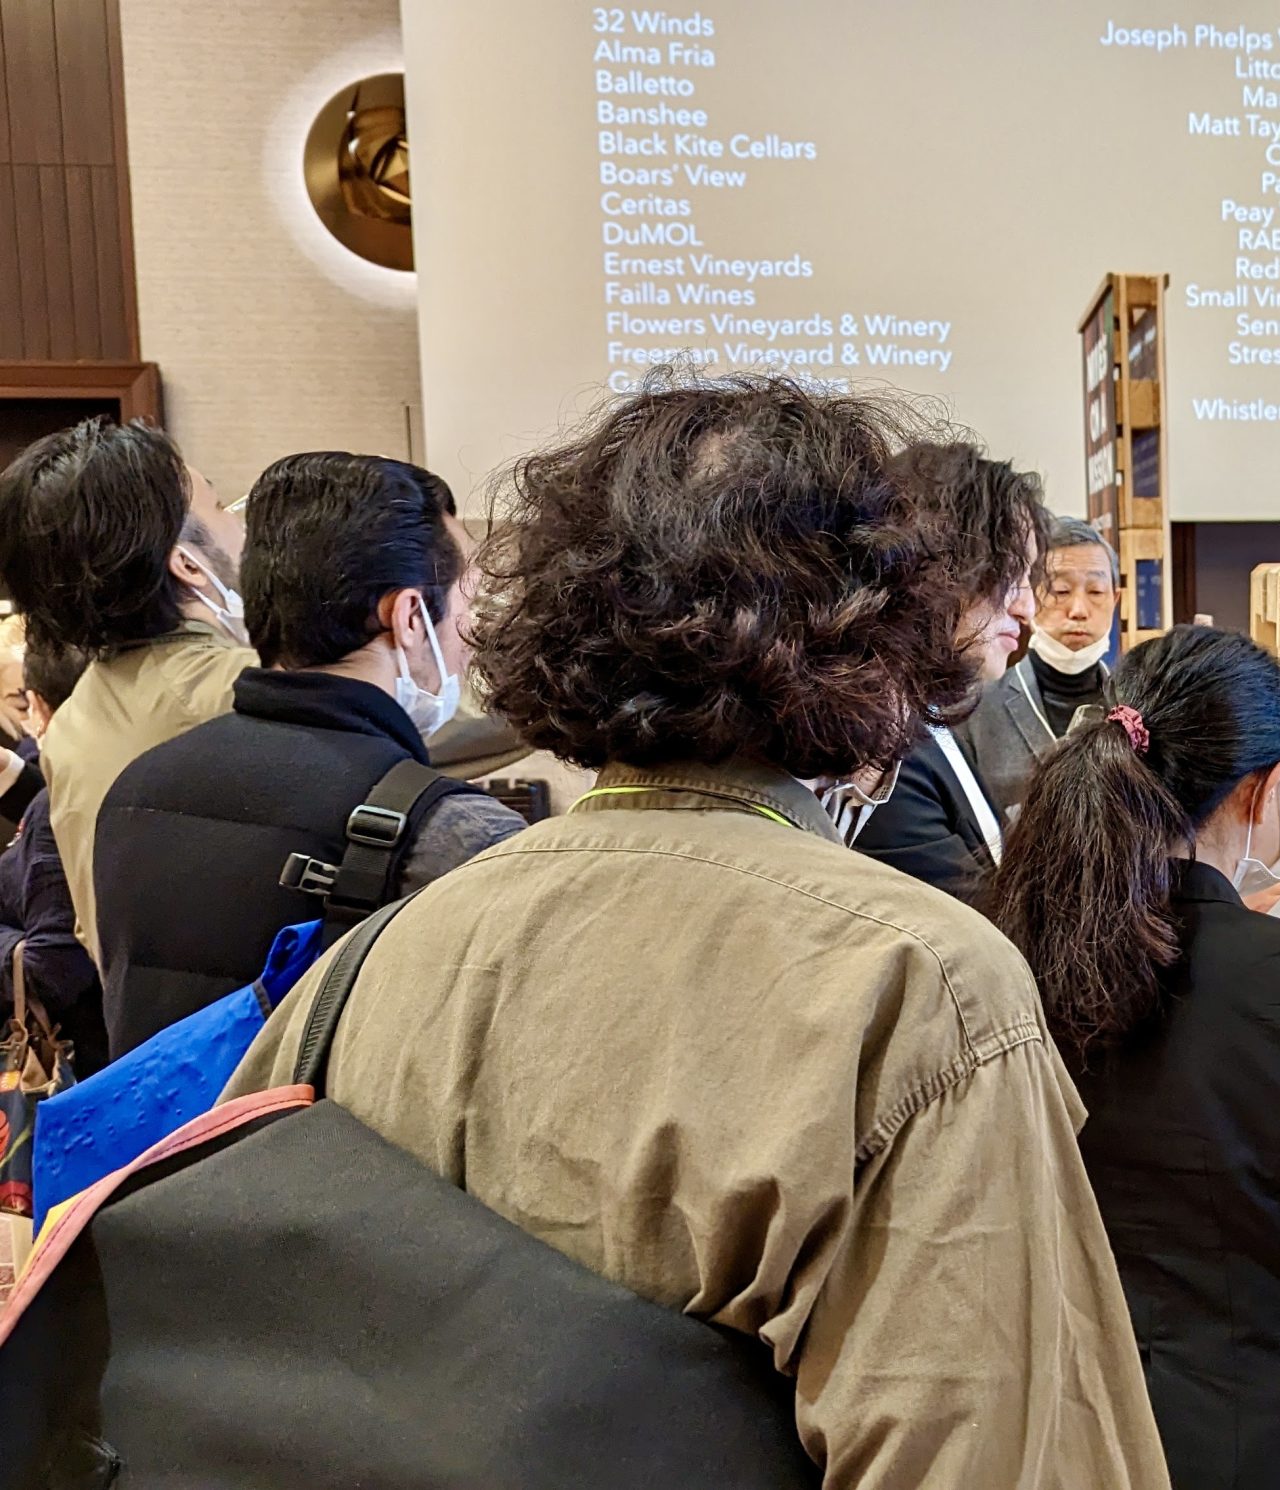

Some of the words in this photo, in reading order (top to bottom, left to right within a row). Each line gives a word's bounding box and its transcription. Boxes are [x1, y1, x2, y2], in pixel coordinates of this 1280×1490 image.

[594, 8, 625, 34] 32
[632, 10, 714, 36] Winds
[1100, 21, 1188, 51] Joseph
[1193, 24, 1273, 54] Phelps
[594, 40, 661, 65] Alma
[668, 41, 715, 67] Fria
[596, 70, 694, 96] Balletto
[597, 101, 708, 127] Banshee
[1188, 113, 1240, 136] Matt
[599, 131, 665, 155] Black
[674, 134, 723, 157] Kite
[729, 134, 816, 160] Cellars
[685, 164, 745, 187] View
[601, 192, 690, 216] Ceritas
[1221, 199, 1273, 226] Peay
[603, 222, 703, 247] DuMOL
[604, 252, 684, 275] Ernest
[690, 255, 812, 282] Vineyards
[1236, 258, 1280, 279] Red
[606, 282, 670, 304] Failla
[676, 284, 755, 305] Wines
[1187, 284, 1248, 307] Small
[607, 312, 704, 335] Flowers
[711, 314, 832, 341] Vineyards
[840, 314, 858, 336] &
[864, 315, 950, 343] Winery
[724, 343, 834, 371] Vineyard
[840, 344, 859, 366] &
[865, 344, 951, 372] Winery
